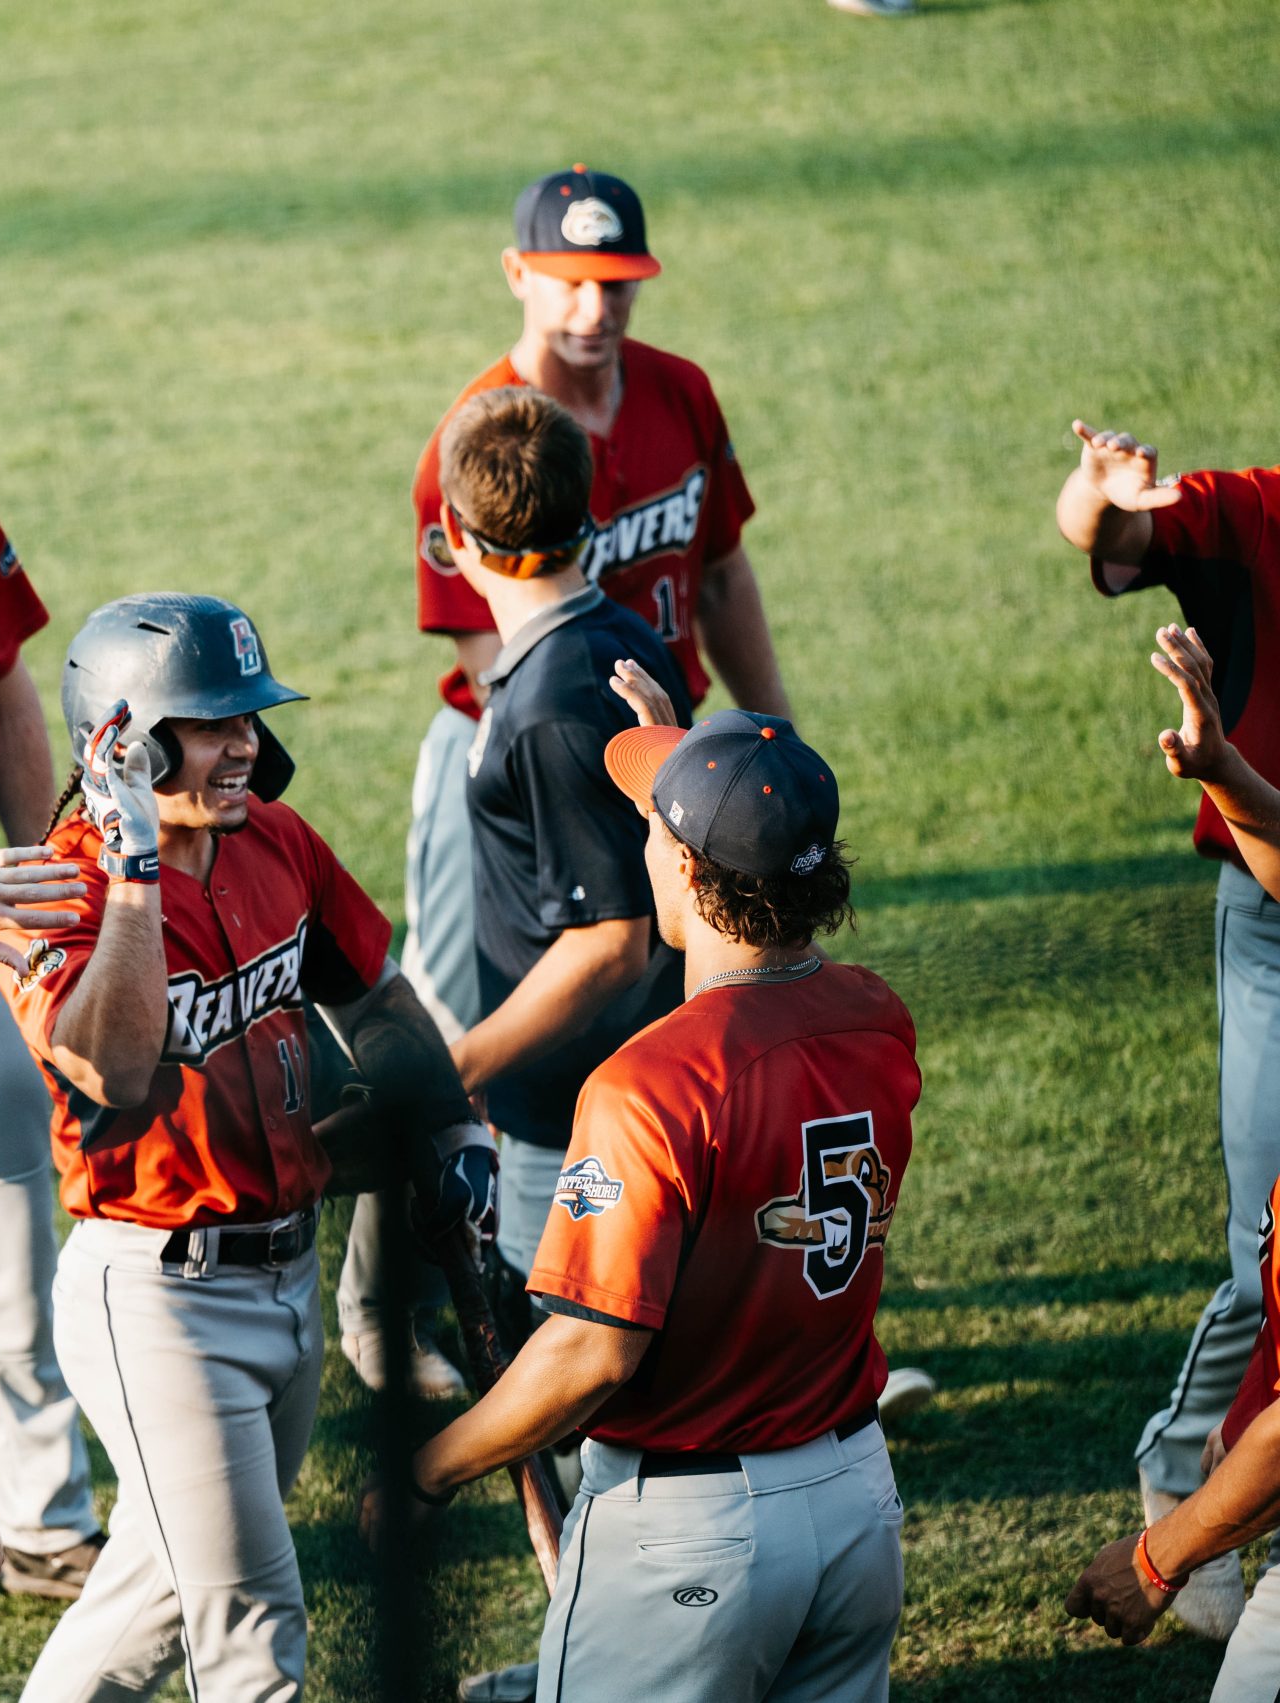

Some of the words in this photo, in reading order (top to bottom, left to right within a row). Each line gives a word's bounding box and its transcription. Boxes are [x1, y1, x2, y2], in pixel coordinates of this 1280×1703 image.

[577, 472, 706, 582] AVERS
[582, 1184, 620, 1200] SHORE
[801, 1110, 875, 1301] 5
